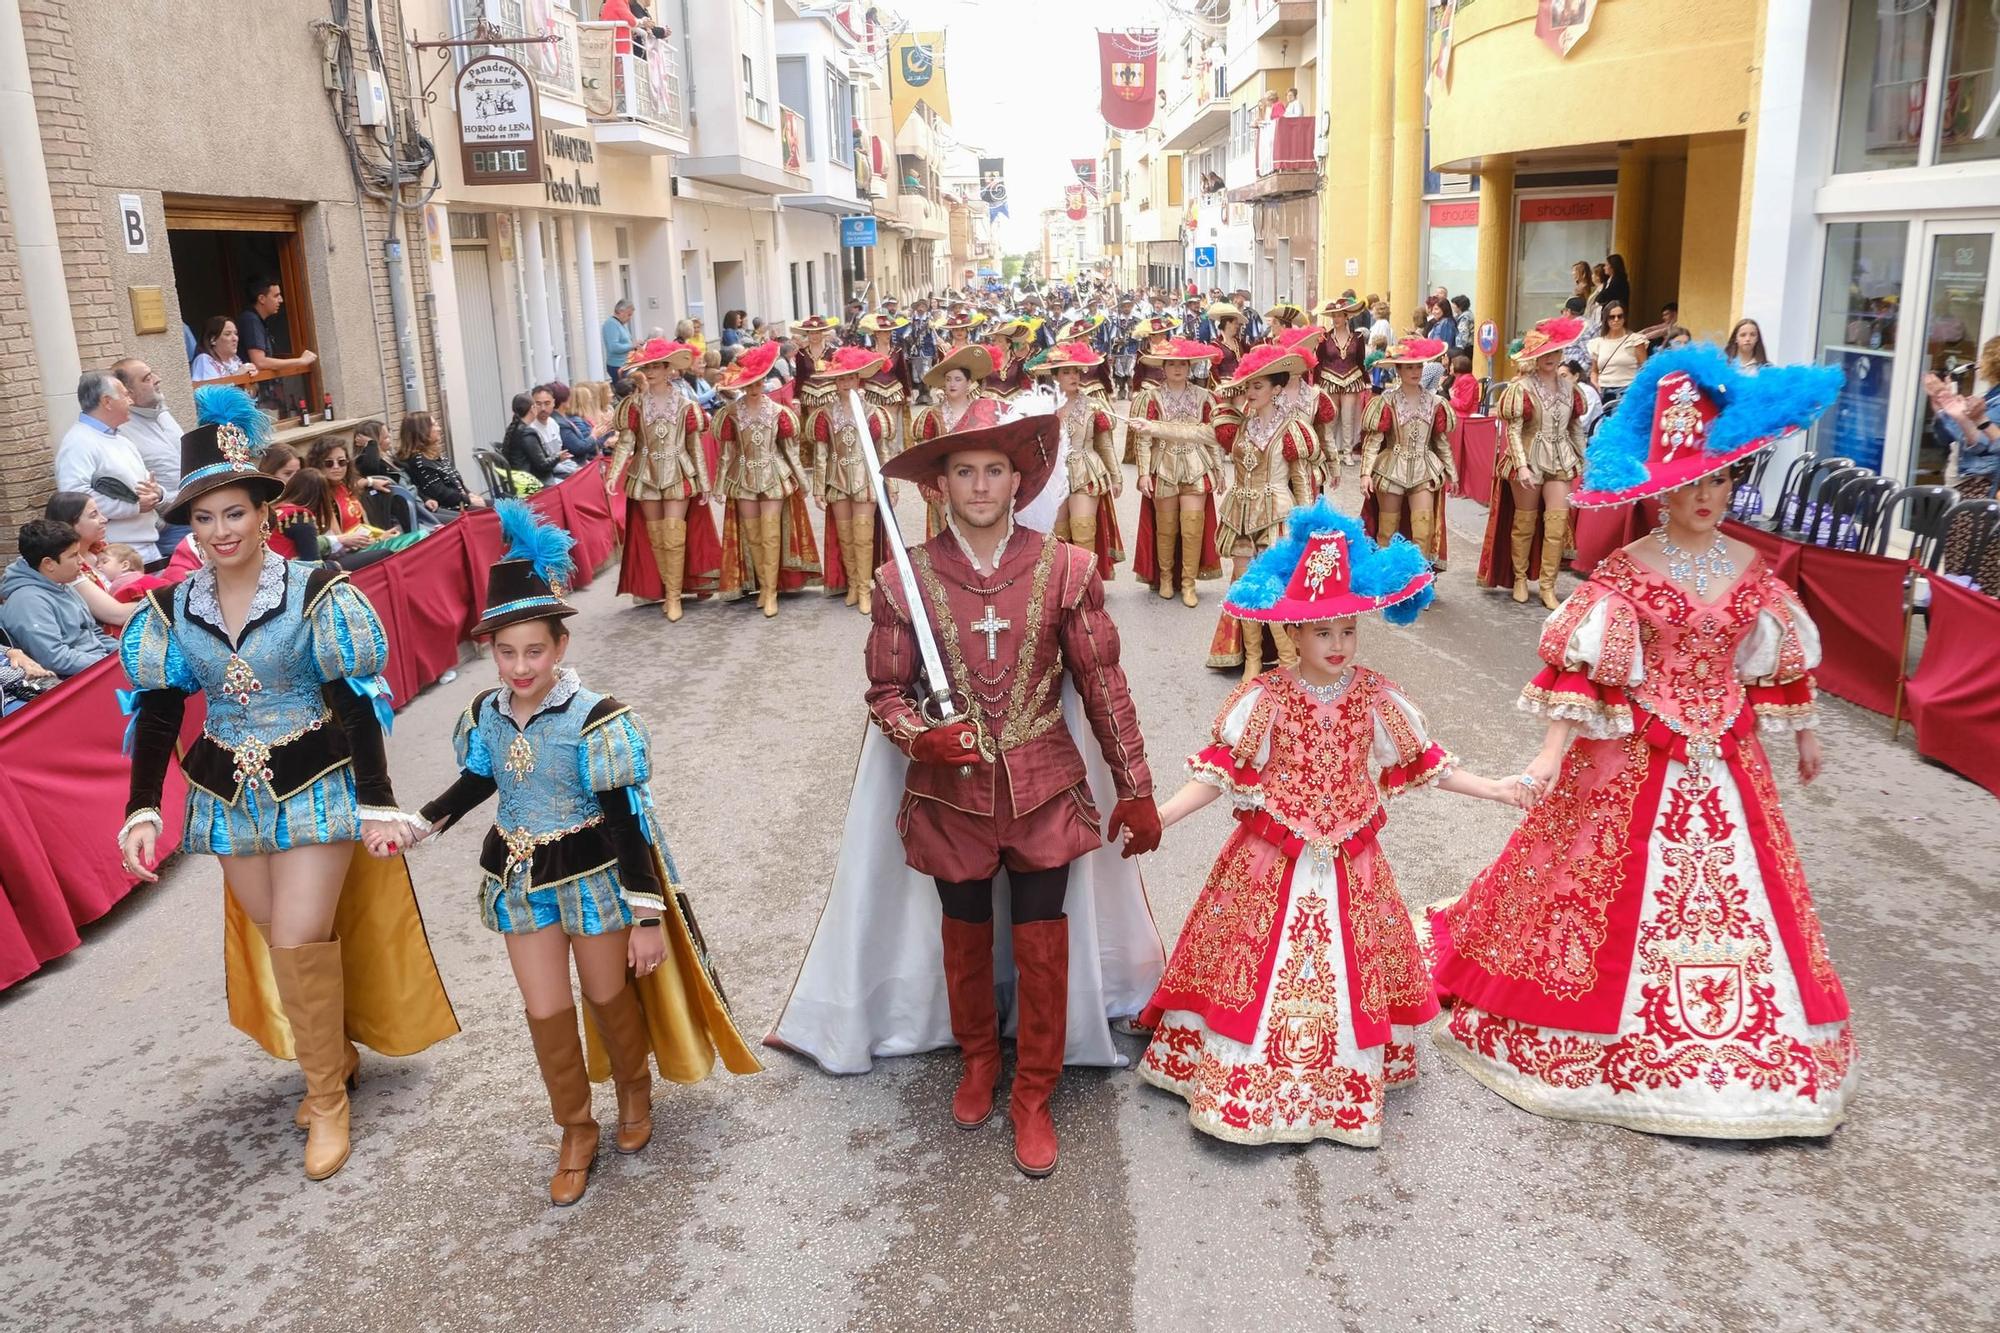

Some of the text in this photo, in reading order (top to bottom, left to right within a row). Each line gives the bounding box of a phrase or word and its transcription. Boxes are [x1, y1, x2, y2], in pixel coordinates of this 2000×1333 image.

[464, 125, 496, 133] HORNO
[509, 122, 531, 131] LEÑA
[544, 164, 574, 203] Pedro
[125, 210, 144, 245] B
